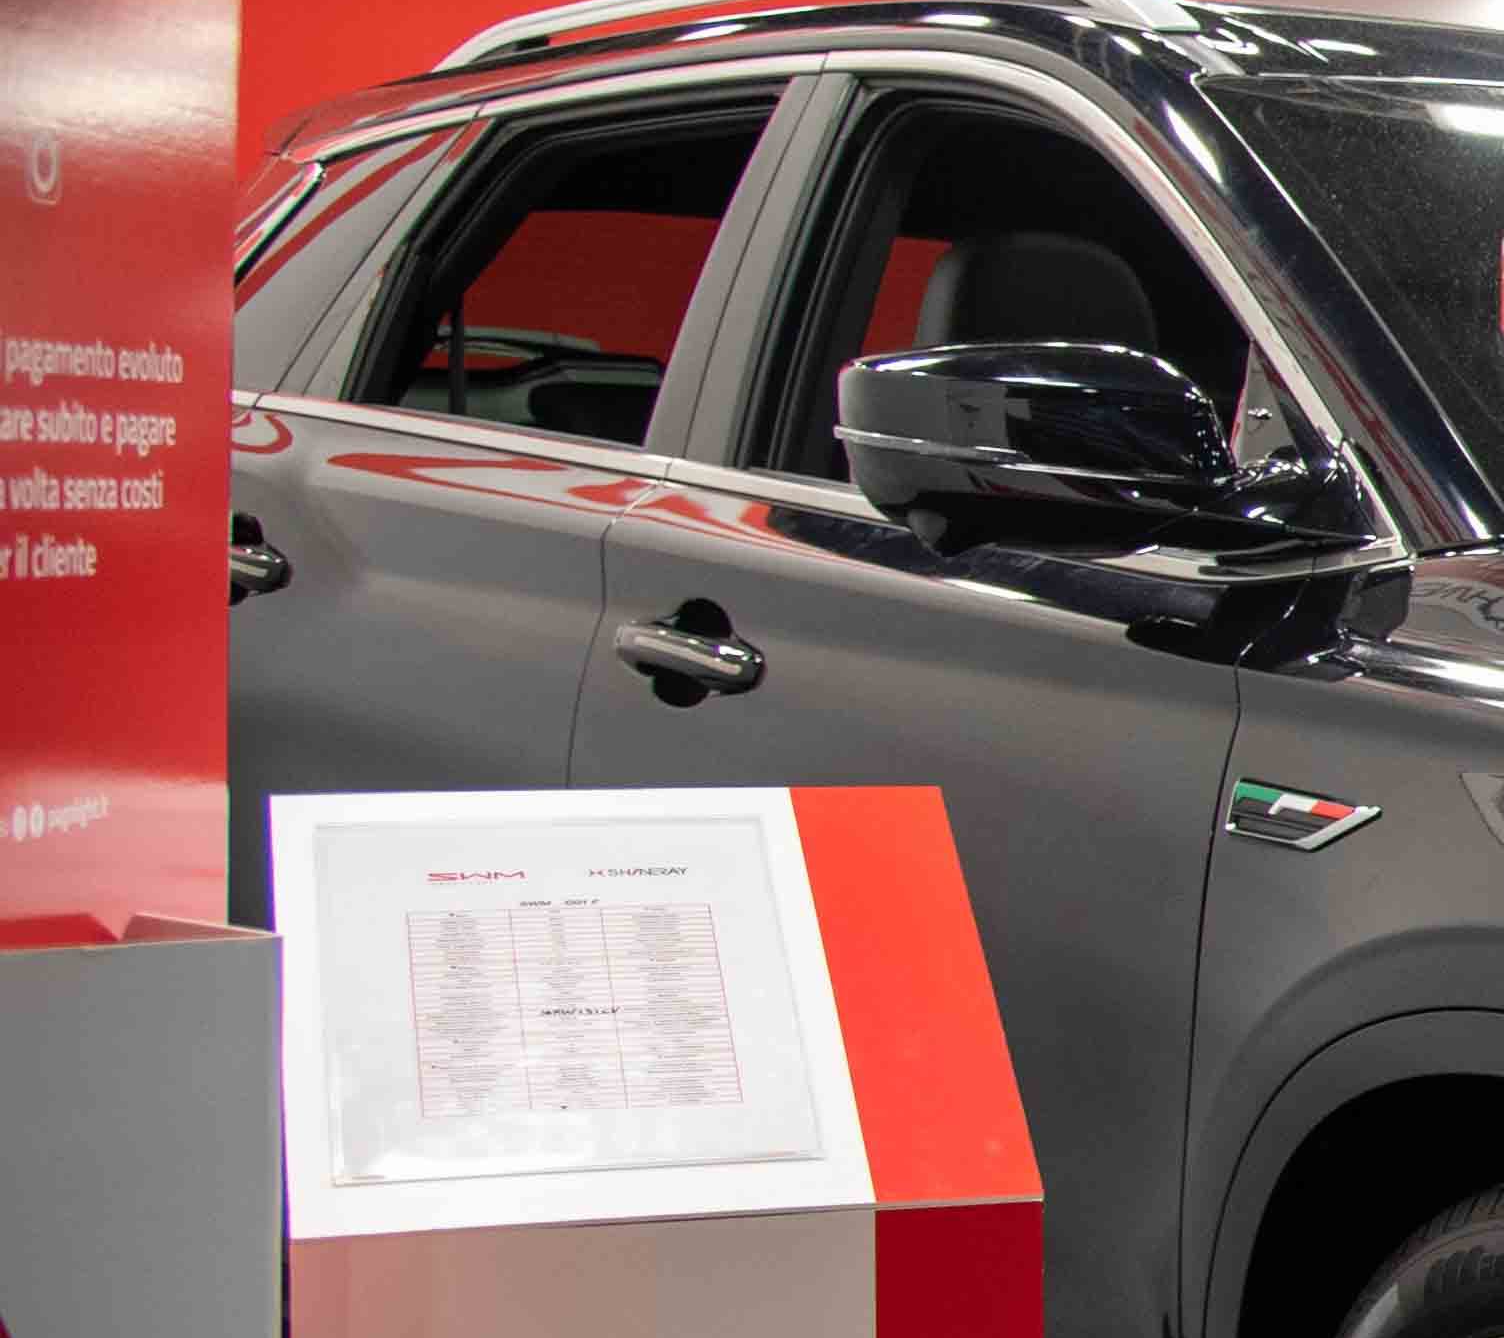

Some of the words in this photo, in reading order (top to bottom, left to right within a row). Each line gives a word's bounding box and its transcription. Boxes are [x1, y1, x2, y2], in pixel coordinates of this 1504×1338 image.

[5, 337, 116, 387] pagamento
[117, 341, 184, 384] evoluto
[36, 399, 97, 443] subito
[99, 412, 113, 444] e
[115, 412, 177, 457] pagare
[9, 465, 61, 510] volta
[62, 476, 118, 510] senza
[120, 468, 165, 509] costi
[31, 533, 98, 578] cliente
[427, 869, 526, 882] SWM
